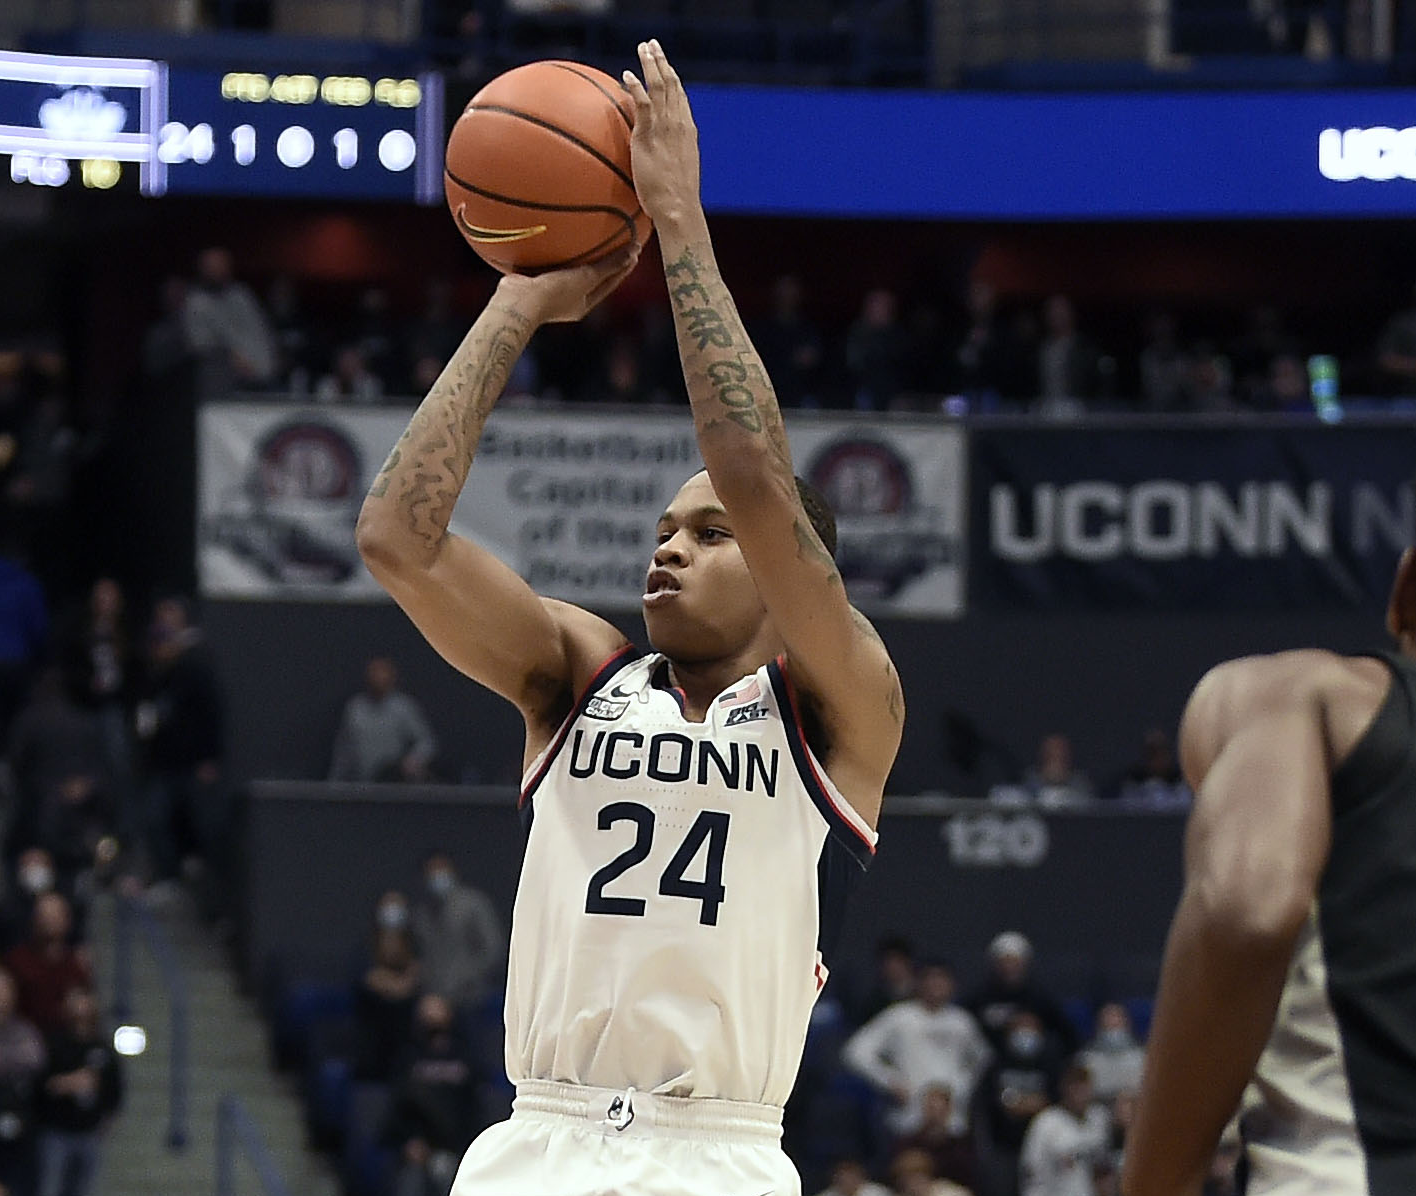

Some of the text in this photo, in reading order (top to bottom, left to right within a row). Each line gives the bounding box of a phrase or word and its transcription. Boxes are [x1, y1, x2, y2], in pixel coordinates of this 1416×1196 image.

[232, 124, 256, 166] 1
[334, 128, 358, 170] 1
[706, 359, 762, 434] GOD
[989, 480, 1331, 561] UCONN
[568, 729, 780, 798] UCONN
[583, 801, 732, 927] 24
[947, 817, 1049, 864] 120
